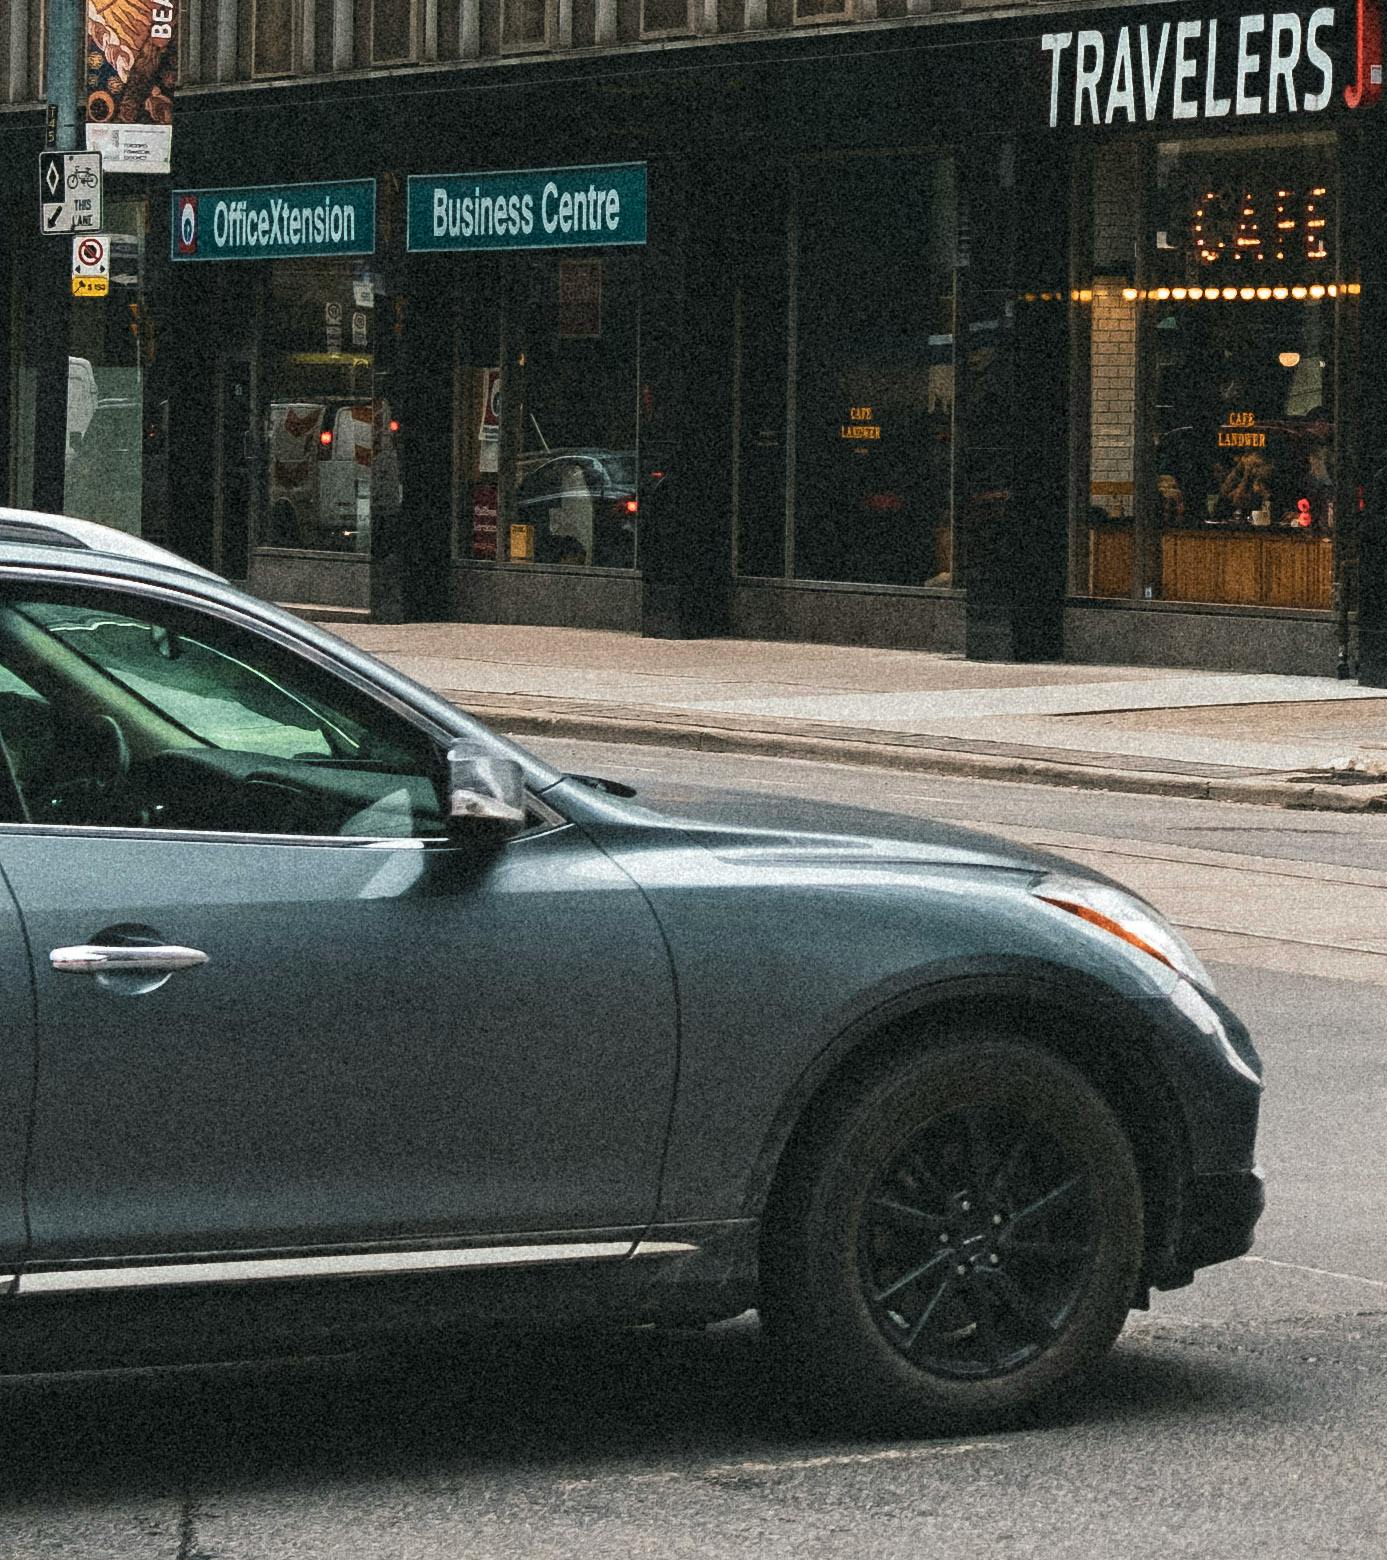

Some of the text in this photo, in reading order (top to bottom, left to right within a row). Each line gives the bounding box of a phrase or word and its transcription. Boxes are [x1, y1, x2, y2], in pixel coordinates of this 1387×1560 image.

[1041, 7, 1336, 129] TRAVELERS
[74, 199, 92, 211] THIS
[213, 195, 356, 248] OfficeXtension
[432, 181, 621, 238] Business Centre
[1195, 187, 1329, 263] CAFE
[1217, 432, 1267, 448] LANDWER
[1229, 411, 1256, 428] CAFE
